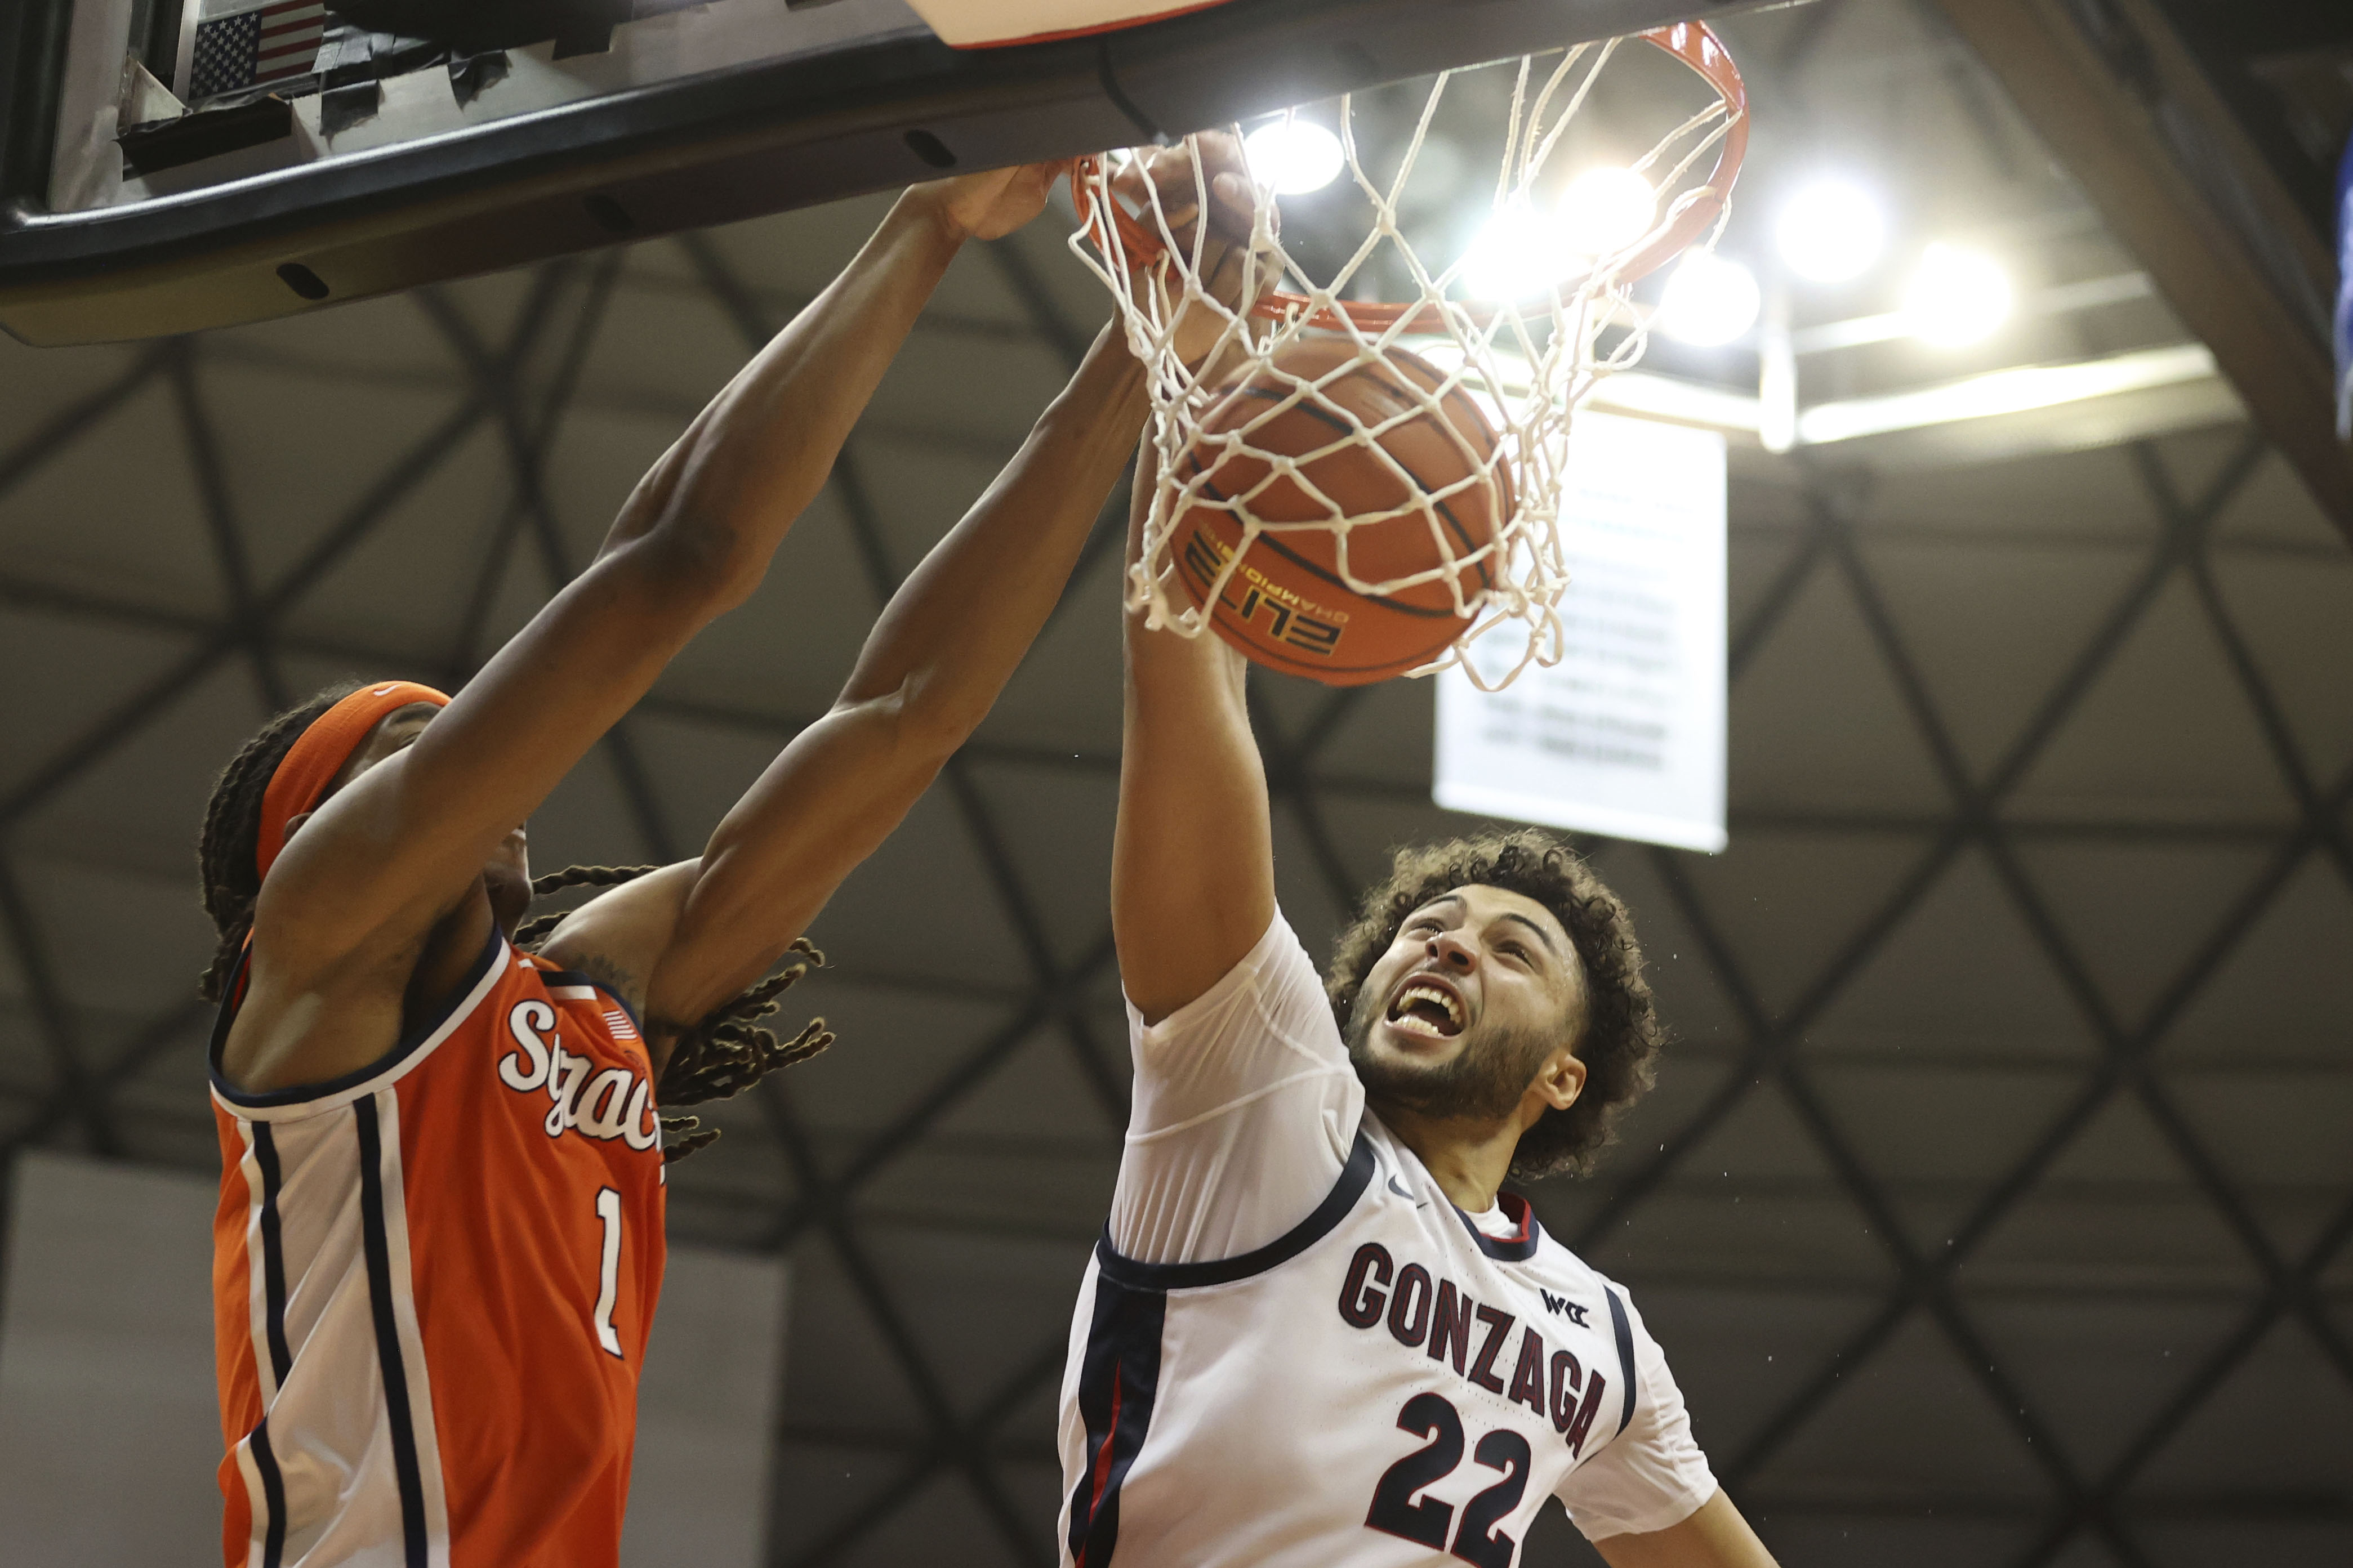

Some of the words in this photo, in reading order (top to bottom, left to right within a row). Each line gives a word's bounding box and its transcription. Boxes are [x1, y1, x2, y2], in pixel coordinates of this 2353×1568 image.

[498, 999, 662, 1153] Syrac
[594, 1186, 624, 1360] 1
[1338, 1242, 1606, 1460] GONZAGA
[1539, 1288, 1590, 1329] WCC
[1364, 1392, 1531, 1568] 22
